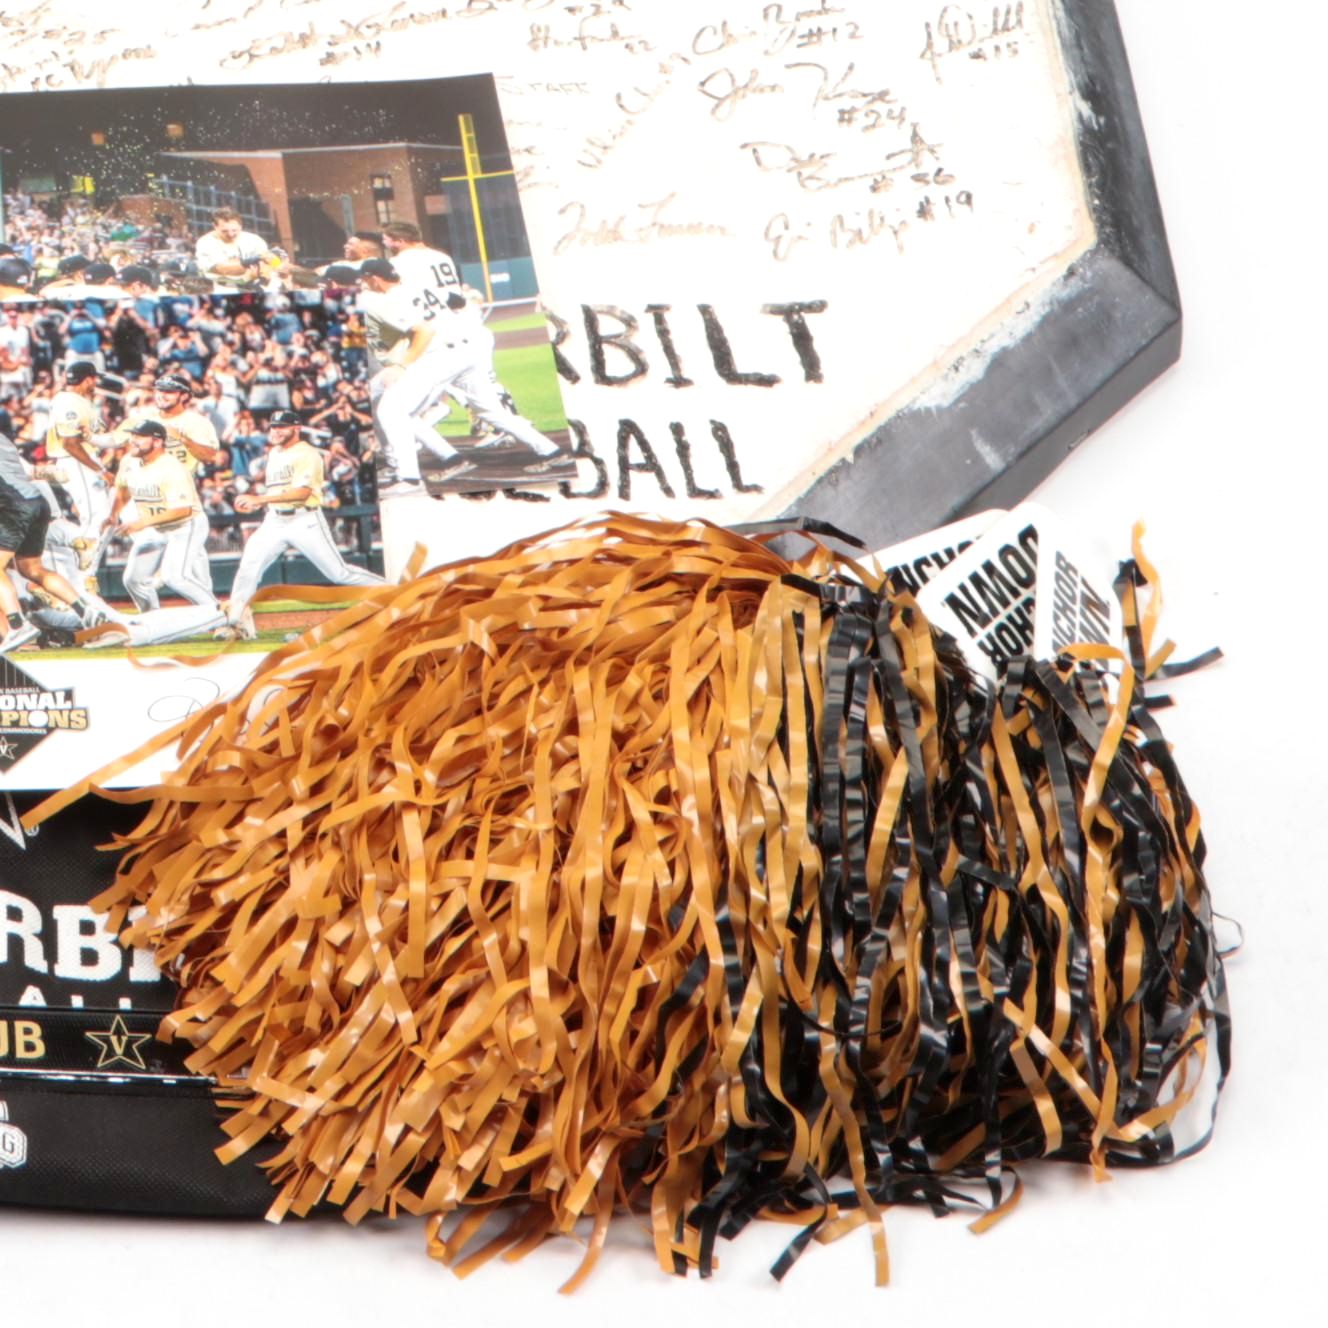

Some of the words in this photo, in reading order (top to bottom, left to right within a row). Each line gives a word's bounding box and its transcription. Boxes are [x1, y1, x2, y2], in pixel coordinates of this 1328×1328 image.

[430, 261, 458, 288] 19
[540, 299, 829, 388] RBILT
[558, 418, 764, 502] BALL
[5, 686, 40, 694] BASEBALL
[0, 727, 48, 735] COMMODORES
[110, 1035, 127, 1056] V
